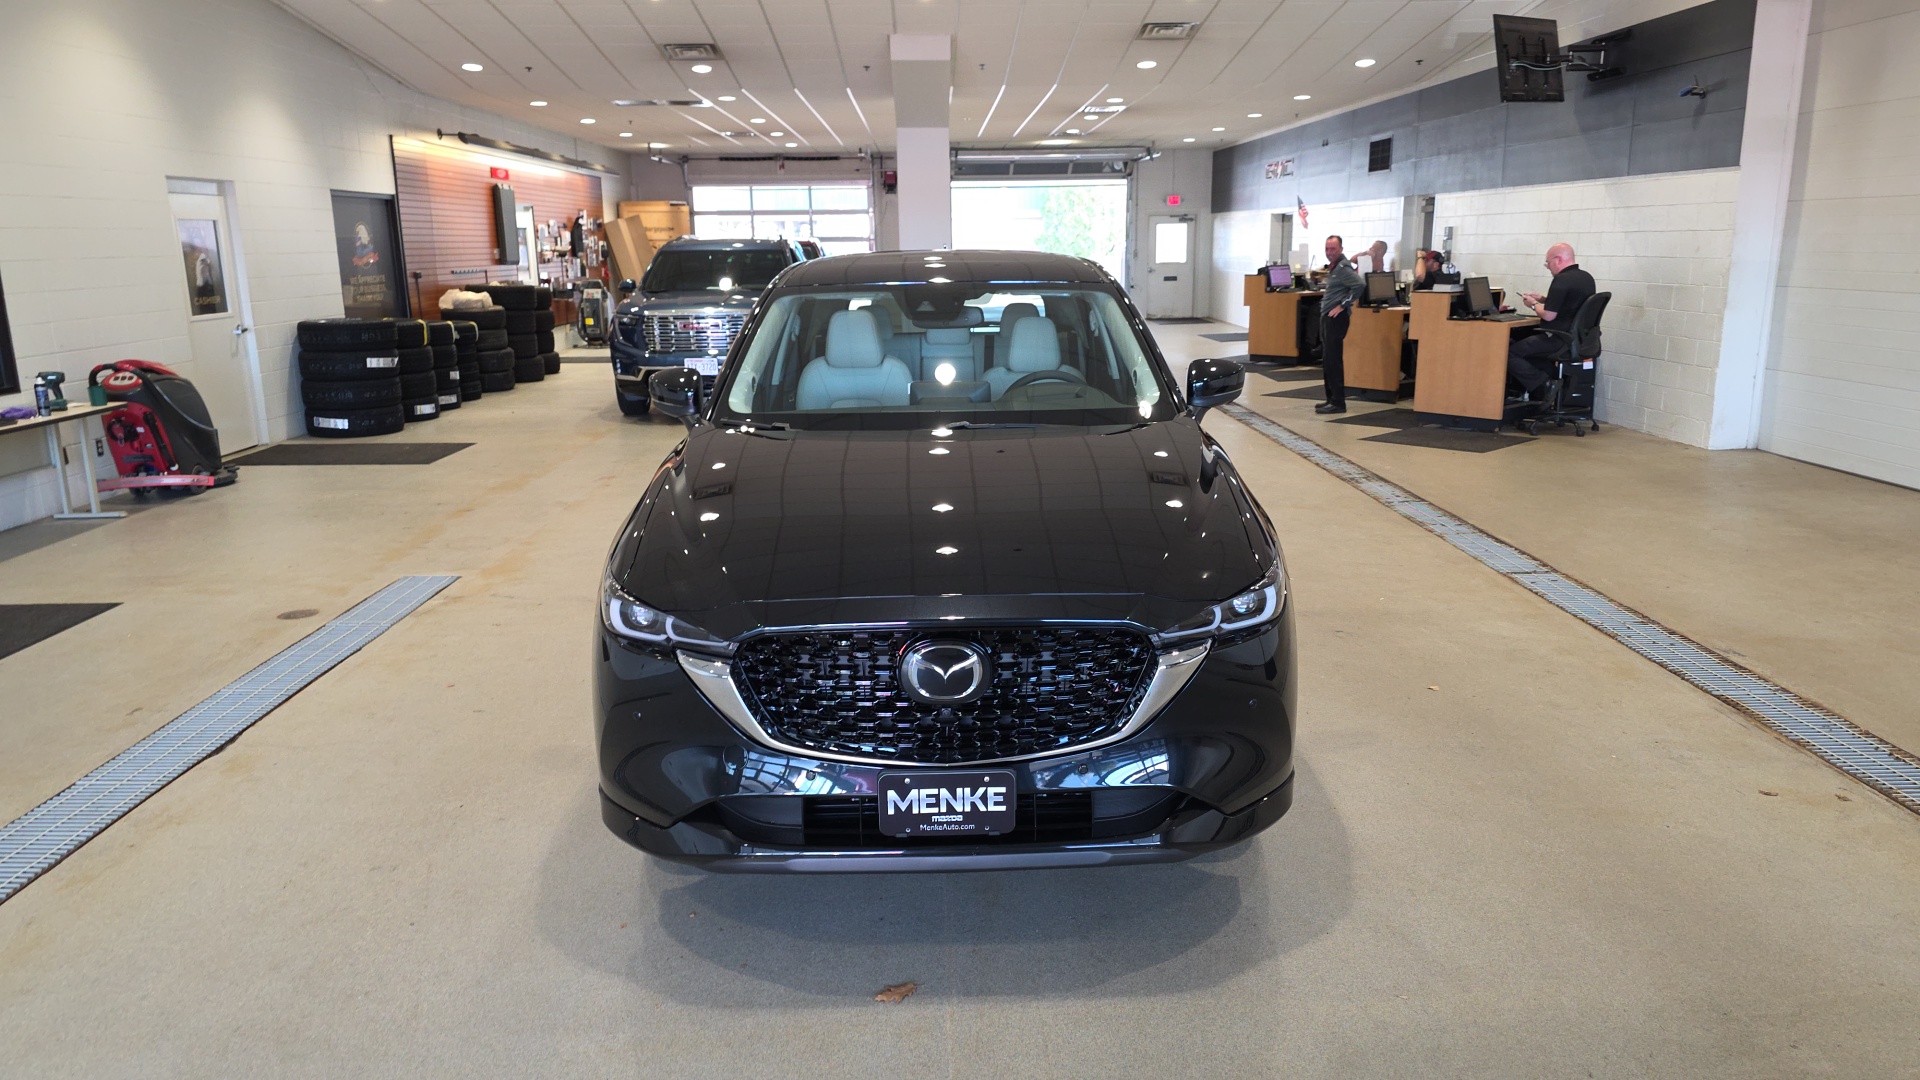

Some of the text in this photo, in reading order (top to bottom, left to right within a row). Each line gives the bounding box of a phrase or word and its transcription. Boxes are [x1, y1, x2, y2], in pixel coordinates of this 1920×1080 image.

[194, 295, 220, 305] CASHIER
[887, 786, 1007, 815] MENKE
[920, 823, 975, 831] MenkeAuto.com
